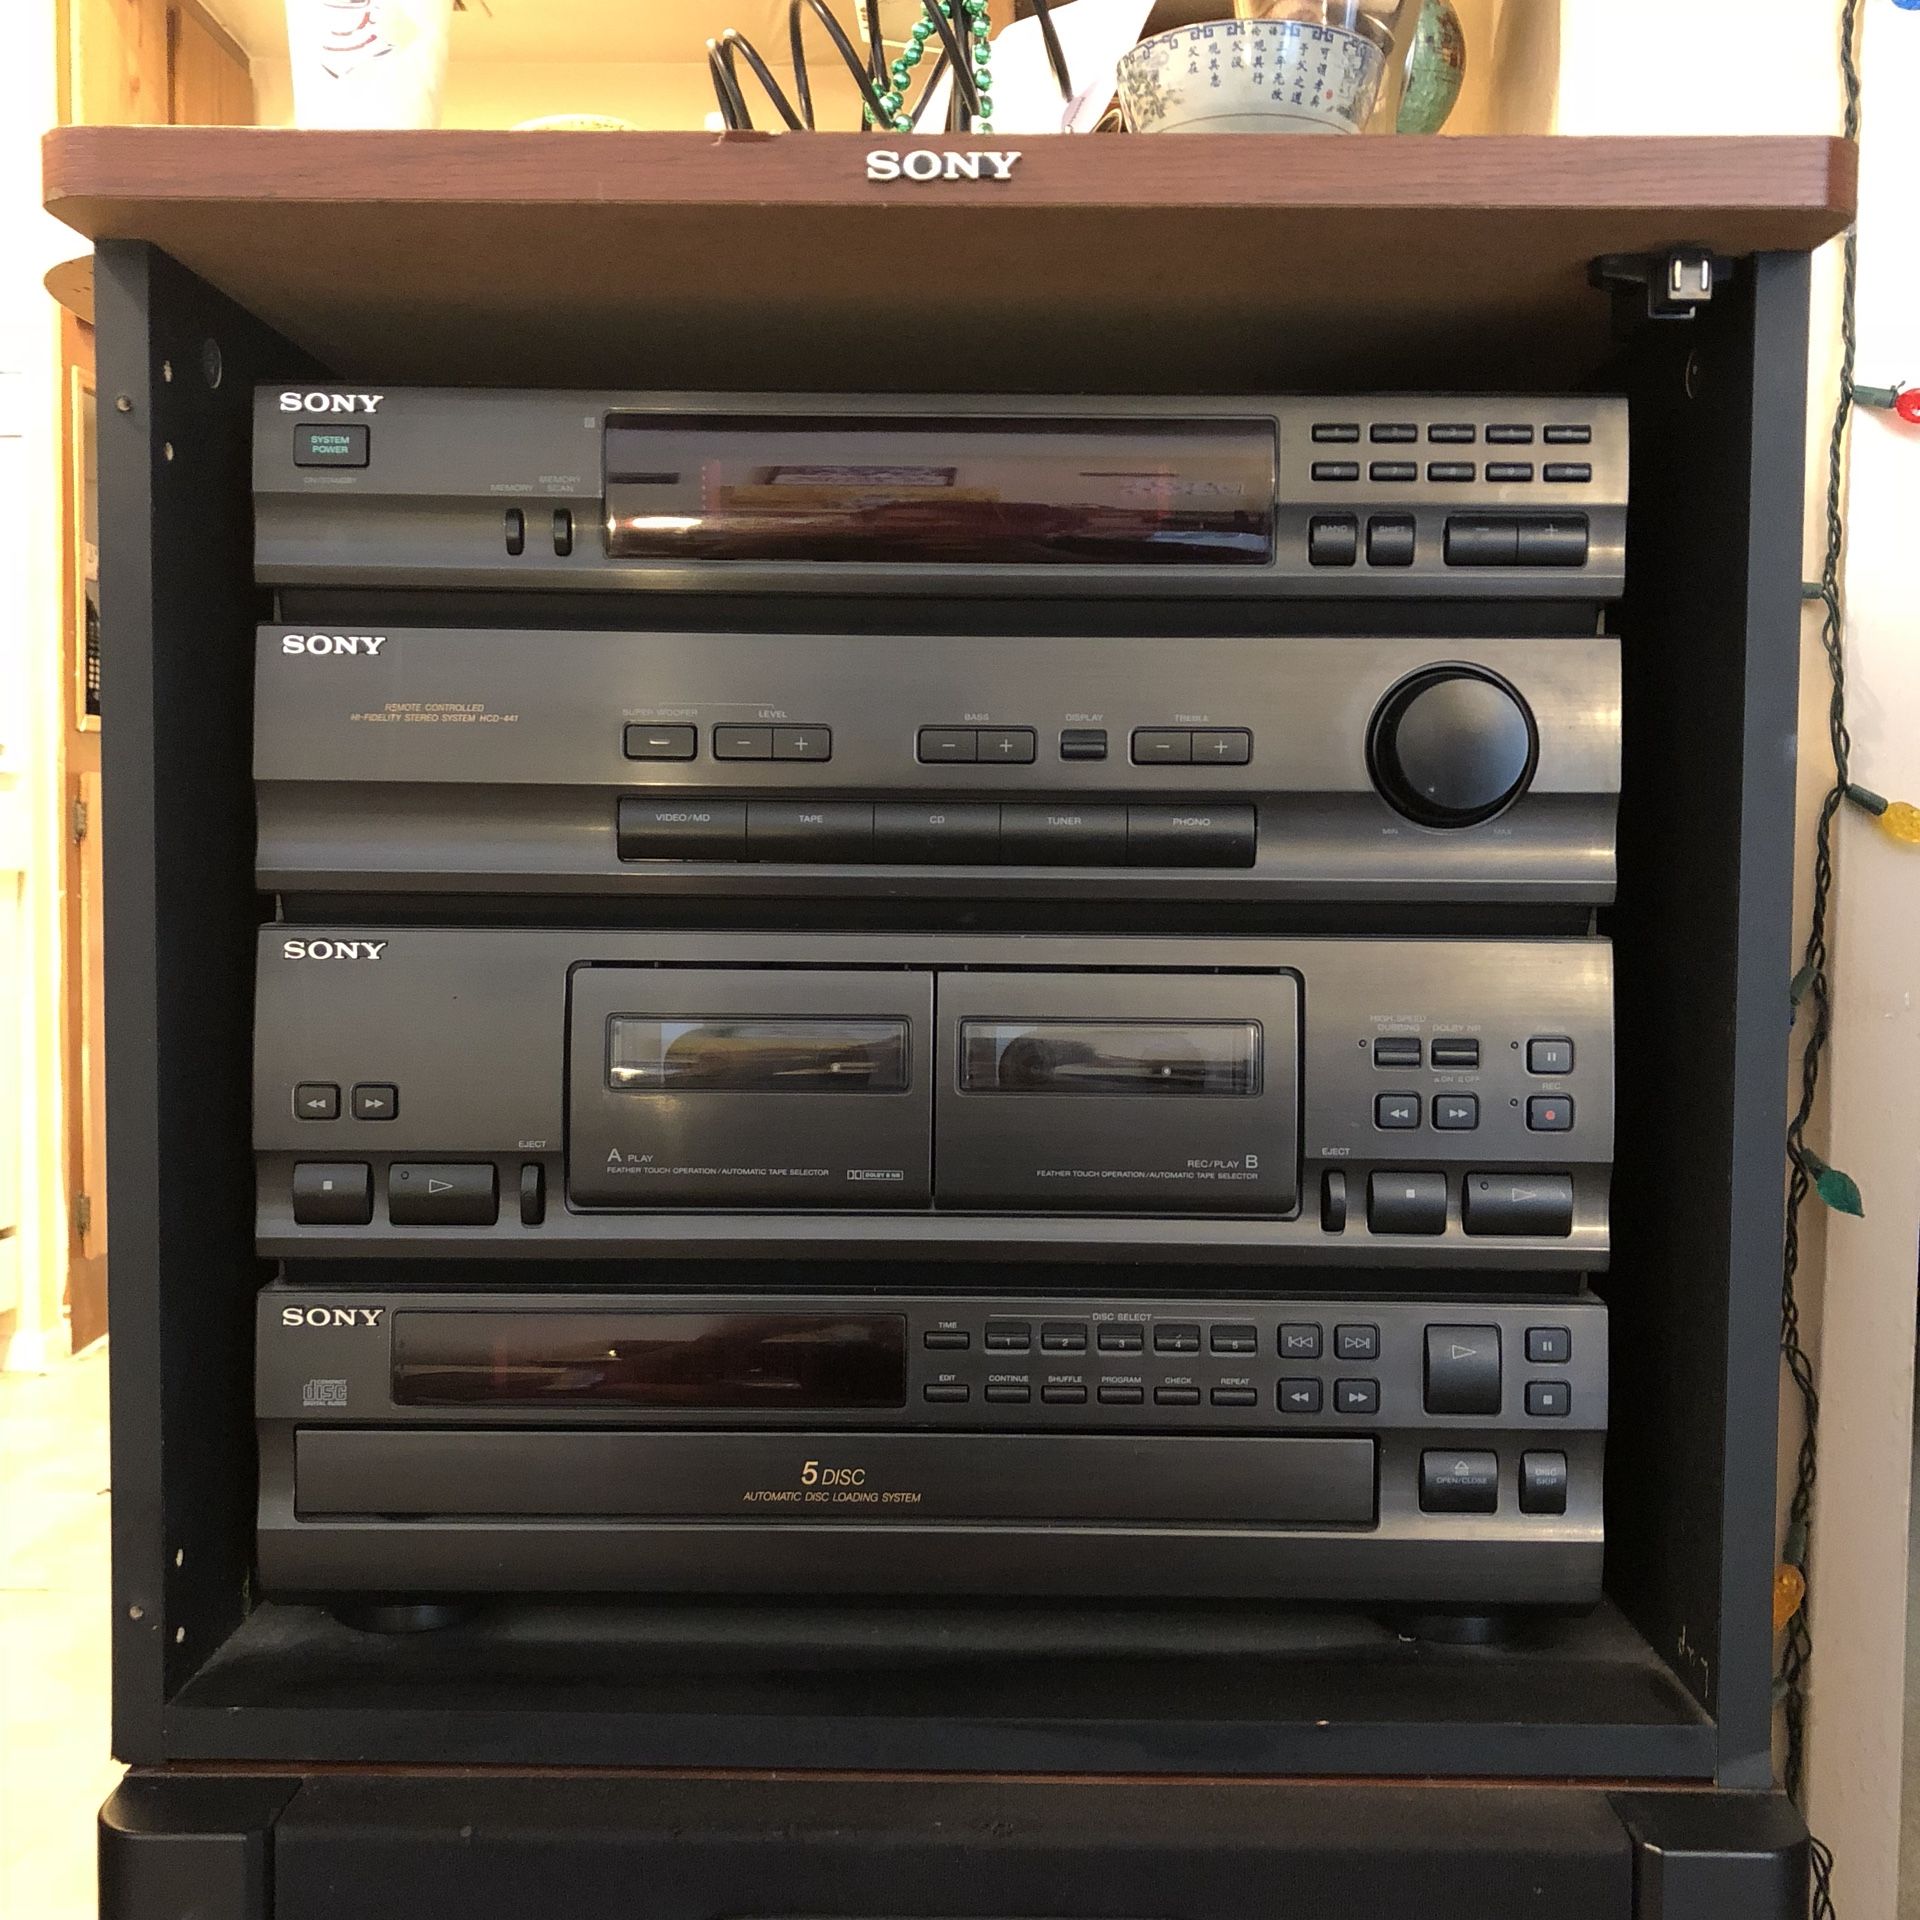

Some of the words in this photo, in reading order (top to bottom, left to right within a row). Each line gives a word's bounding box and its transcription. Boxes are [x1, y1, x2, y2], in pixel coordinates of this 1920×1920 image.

[866, 150, 1022, 181] SONY
[279, 392, 384, 413] SONY
[310, 435, 350, 444] SYSTEM
[312, 445, 349, 454] POWER
[282, 634, 387, 655] SONY
[384, 703, 422, 712] REMOTE
[425, 703, 484, 712] CONTROLLED
[656, 708, 699, 717] WOOFER
[758, 710, 788, 719] LEVEL
[350, 713, 402, 722] HI-FIDELITY
[404, 714, 439, 723] STEREO
[441, 714, 476, 723] SYSTEM
[479, 714, 519, 723] HCD-441
[964, 713, 990, 722] BASS
[1065, 713, 1104, 722] DISPLAY
[655, 813, 711, 823] VIDEO/MD
[799, 814, 824, 824] TAPE
[929, 816, 945, 825] CD
[1047, 816, 1082, 825] TUNER
[1172, 818, 1211, 827] PHONO
[283, 941, 387, 960] SONY
[1542, 1082, 1561, 1090] REC
[518, 1140, 547, 1148] EJECT
[607, 1148, 622, 1163] A
[627, 1154, 654, 1164] PLAY
[1322, 1148, 1350, 1156] EJECT
[1187, 1159, 1240, 1170] REC/PLAY
[1245, 1154, 1258, 1169] B
[606, 1166, 642, 1175] FEATHER
[643, 1167, 671, 1175] TOUCH
[768, 1168, 788, 1176] TAPE
[789, 1168, 829, 1177] SELECTOR
[1036, 1169, 1072, 1178] FEATHER
[1072, 1170, 1100, 1178] TOUCH
[1196, 1172, 1215, 1180] TAPE
[1217, 1172, 1258, 1180] SELECTOR
[281, 1308, 384, 1327] SONY
[1092, 1313, 1114, 1322] DISC
[1117, 1313, 1152, 1322] SELECT
[1062, 1338, 1069, 1347] 2
[1118, 1339, 1125, 1348] 3
[1175, 1340, 1182, 1349] 4
[939, 1374, 956, 1382] EDIT
[988, 1375, 1029, 1383] CONTINUE
[1048, 1375, 1082, 1383] SHUFFLE
[1101, 1376, 1142, 1384] PROGRAM
[1164, 1377, 1192, 1385] CHECK
[1220, 1378, 1250, 1386] REPEAT
[302, 1379, 348, 1401] disc
[800, 1460, 819, 1485] 5
[821, 1468, 866, 1486] DISC
[1436, 1476, 1488, 1485] OPEN/CLOSE
[743, 1491, 802, 1502] AUTOMATIC
[804, 1492, 830, 1502] DISC
[832, 1492, 879, 1503] LOADING
[881, 1492, 922, 1504] SYSTEM
